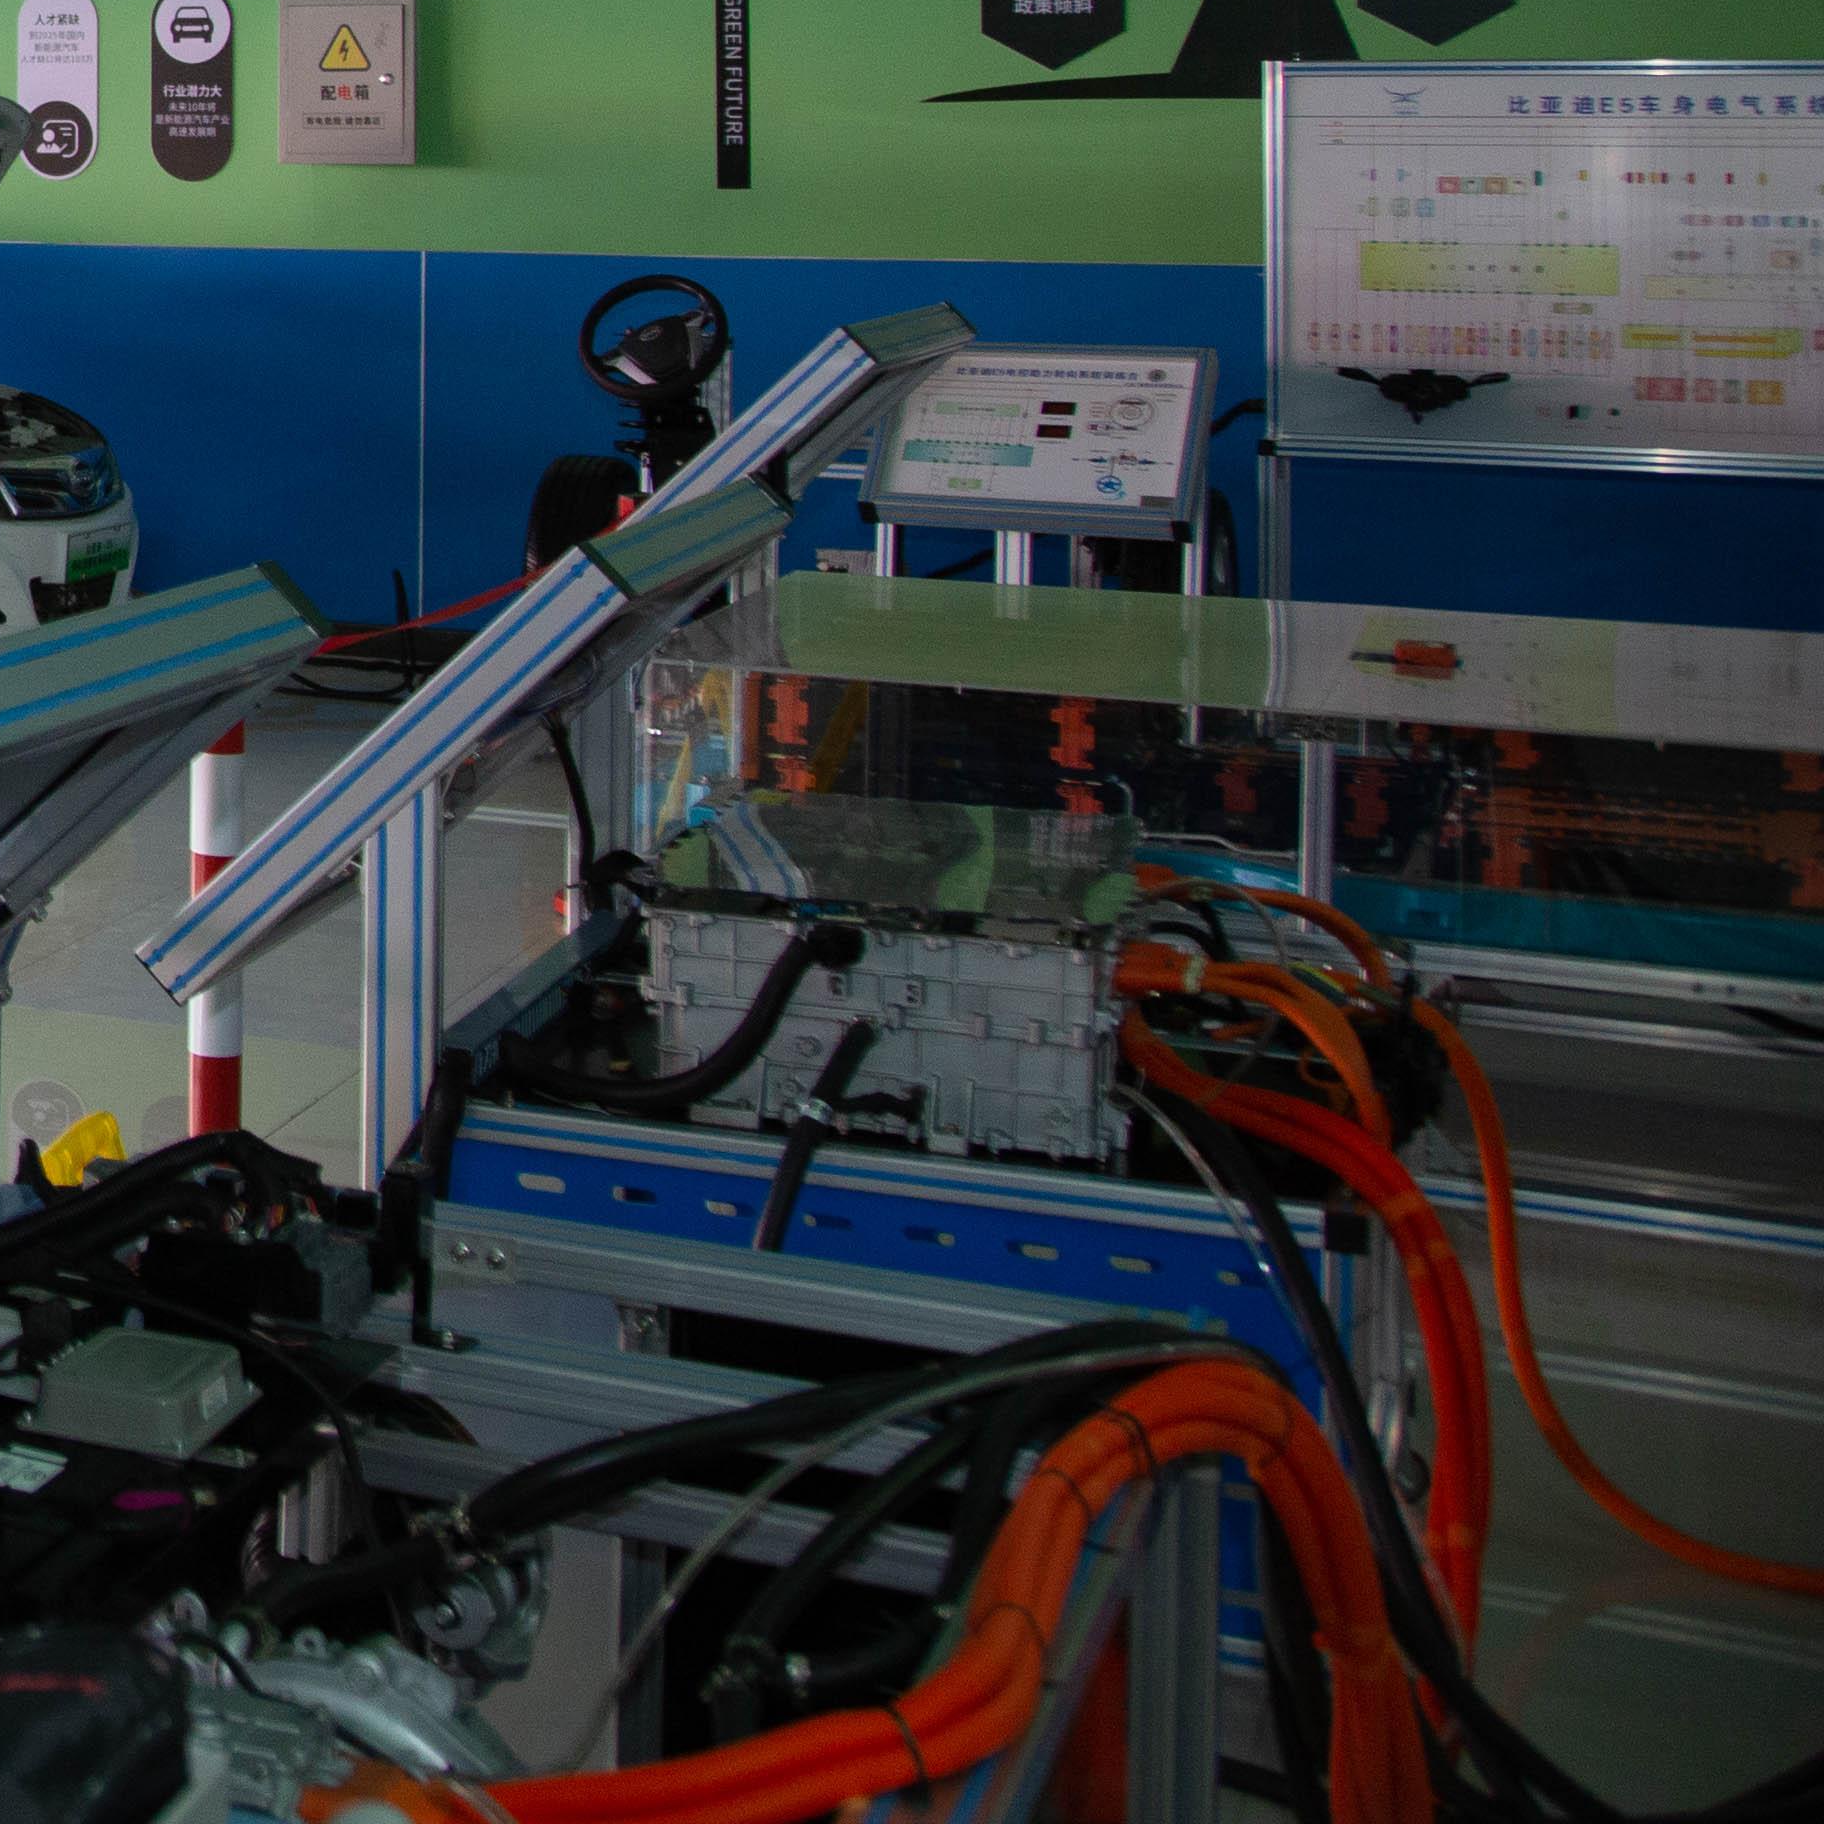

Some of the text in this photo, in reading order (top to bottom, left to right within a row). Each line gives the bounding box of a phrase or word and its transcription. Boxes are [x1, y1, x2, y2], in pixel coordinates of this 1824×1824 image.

[35, 14, 80, 26] 人才紧缺
[163, 84, 222, 98] 行业潜力大
[320, 84, 370, 101] 配电箱
[725, 68, 744, 146] FUTURE
